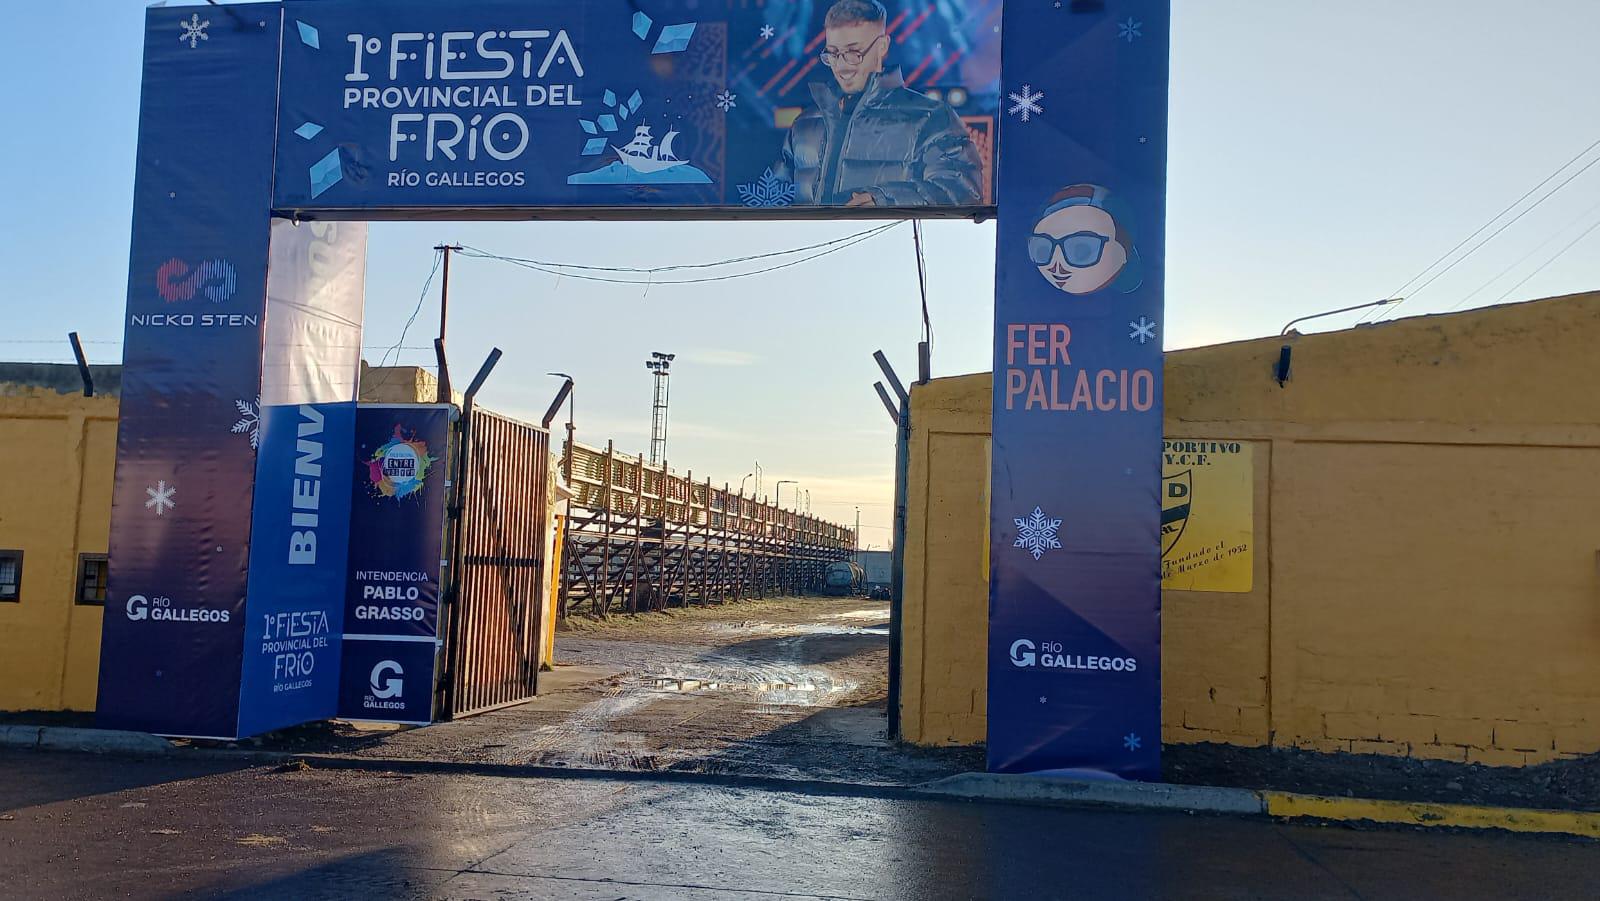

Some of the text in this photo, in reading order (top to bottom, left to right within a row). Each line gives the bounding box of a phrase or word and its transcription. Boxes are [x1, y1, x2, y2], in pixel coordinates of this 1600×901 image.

[389, 29, 584, 81] FIESTA
[343, 84, 583, 109] PROVINCIAL DEL
[389, 112, 530, 162] FRÍO
[387, 169, 526, 188] RÍO GALLEGOS
[131, 314, 258, 326] NICKO STEN
[1006, 323, 1072, 366] FER
[1004, 368, 1154, 413] PALACIO
[389, 459, 414, 468] ENTRE
[1168, 483, 1188, 497] D
[1178, 558, 1209, 574] Marzo
[356, 570, 429, 581] INTENDENCIA
[363, 585, 419, 600] PABLO
[152, 595, 170, 608] RÍO
[151, 608, 230, 622] GALLEGOS
[355, 605, 425, 621] GRASSO
[276, 610, 329, 639] FIESTA
[262, 636, 328, 654] PROVINCIAL DEL
[1041, 641, 1063, 653] RÍO
[274, 651, 315, 680] FRÍO
[1040, 653, 1137, 672] GALLEGOS
[273, 679, 313, 693] RÍO GALLEGOS
[363, 701, 406, 710] GALLEGOS
